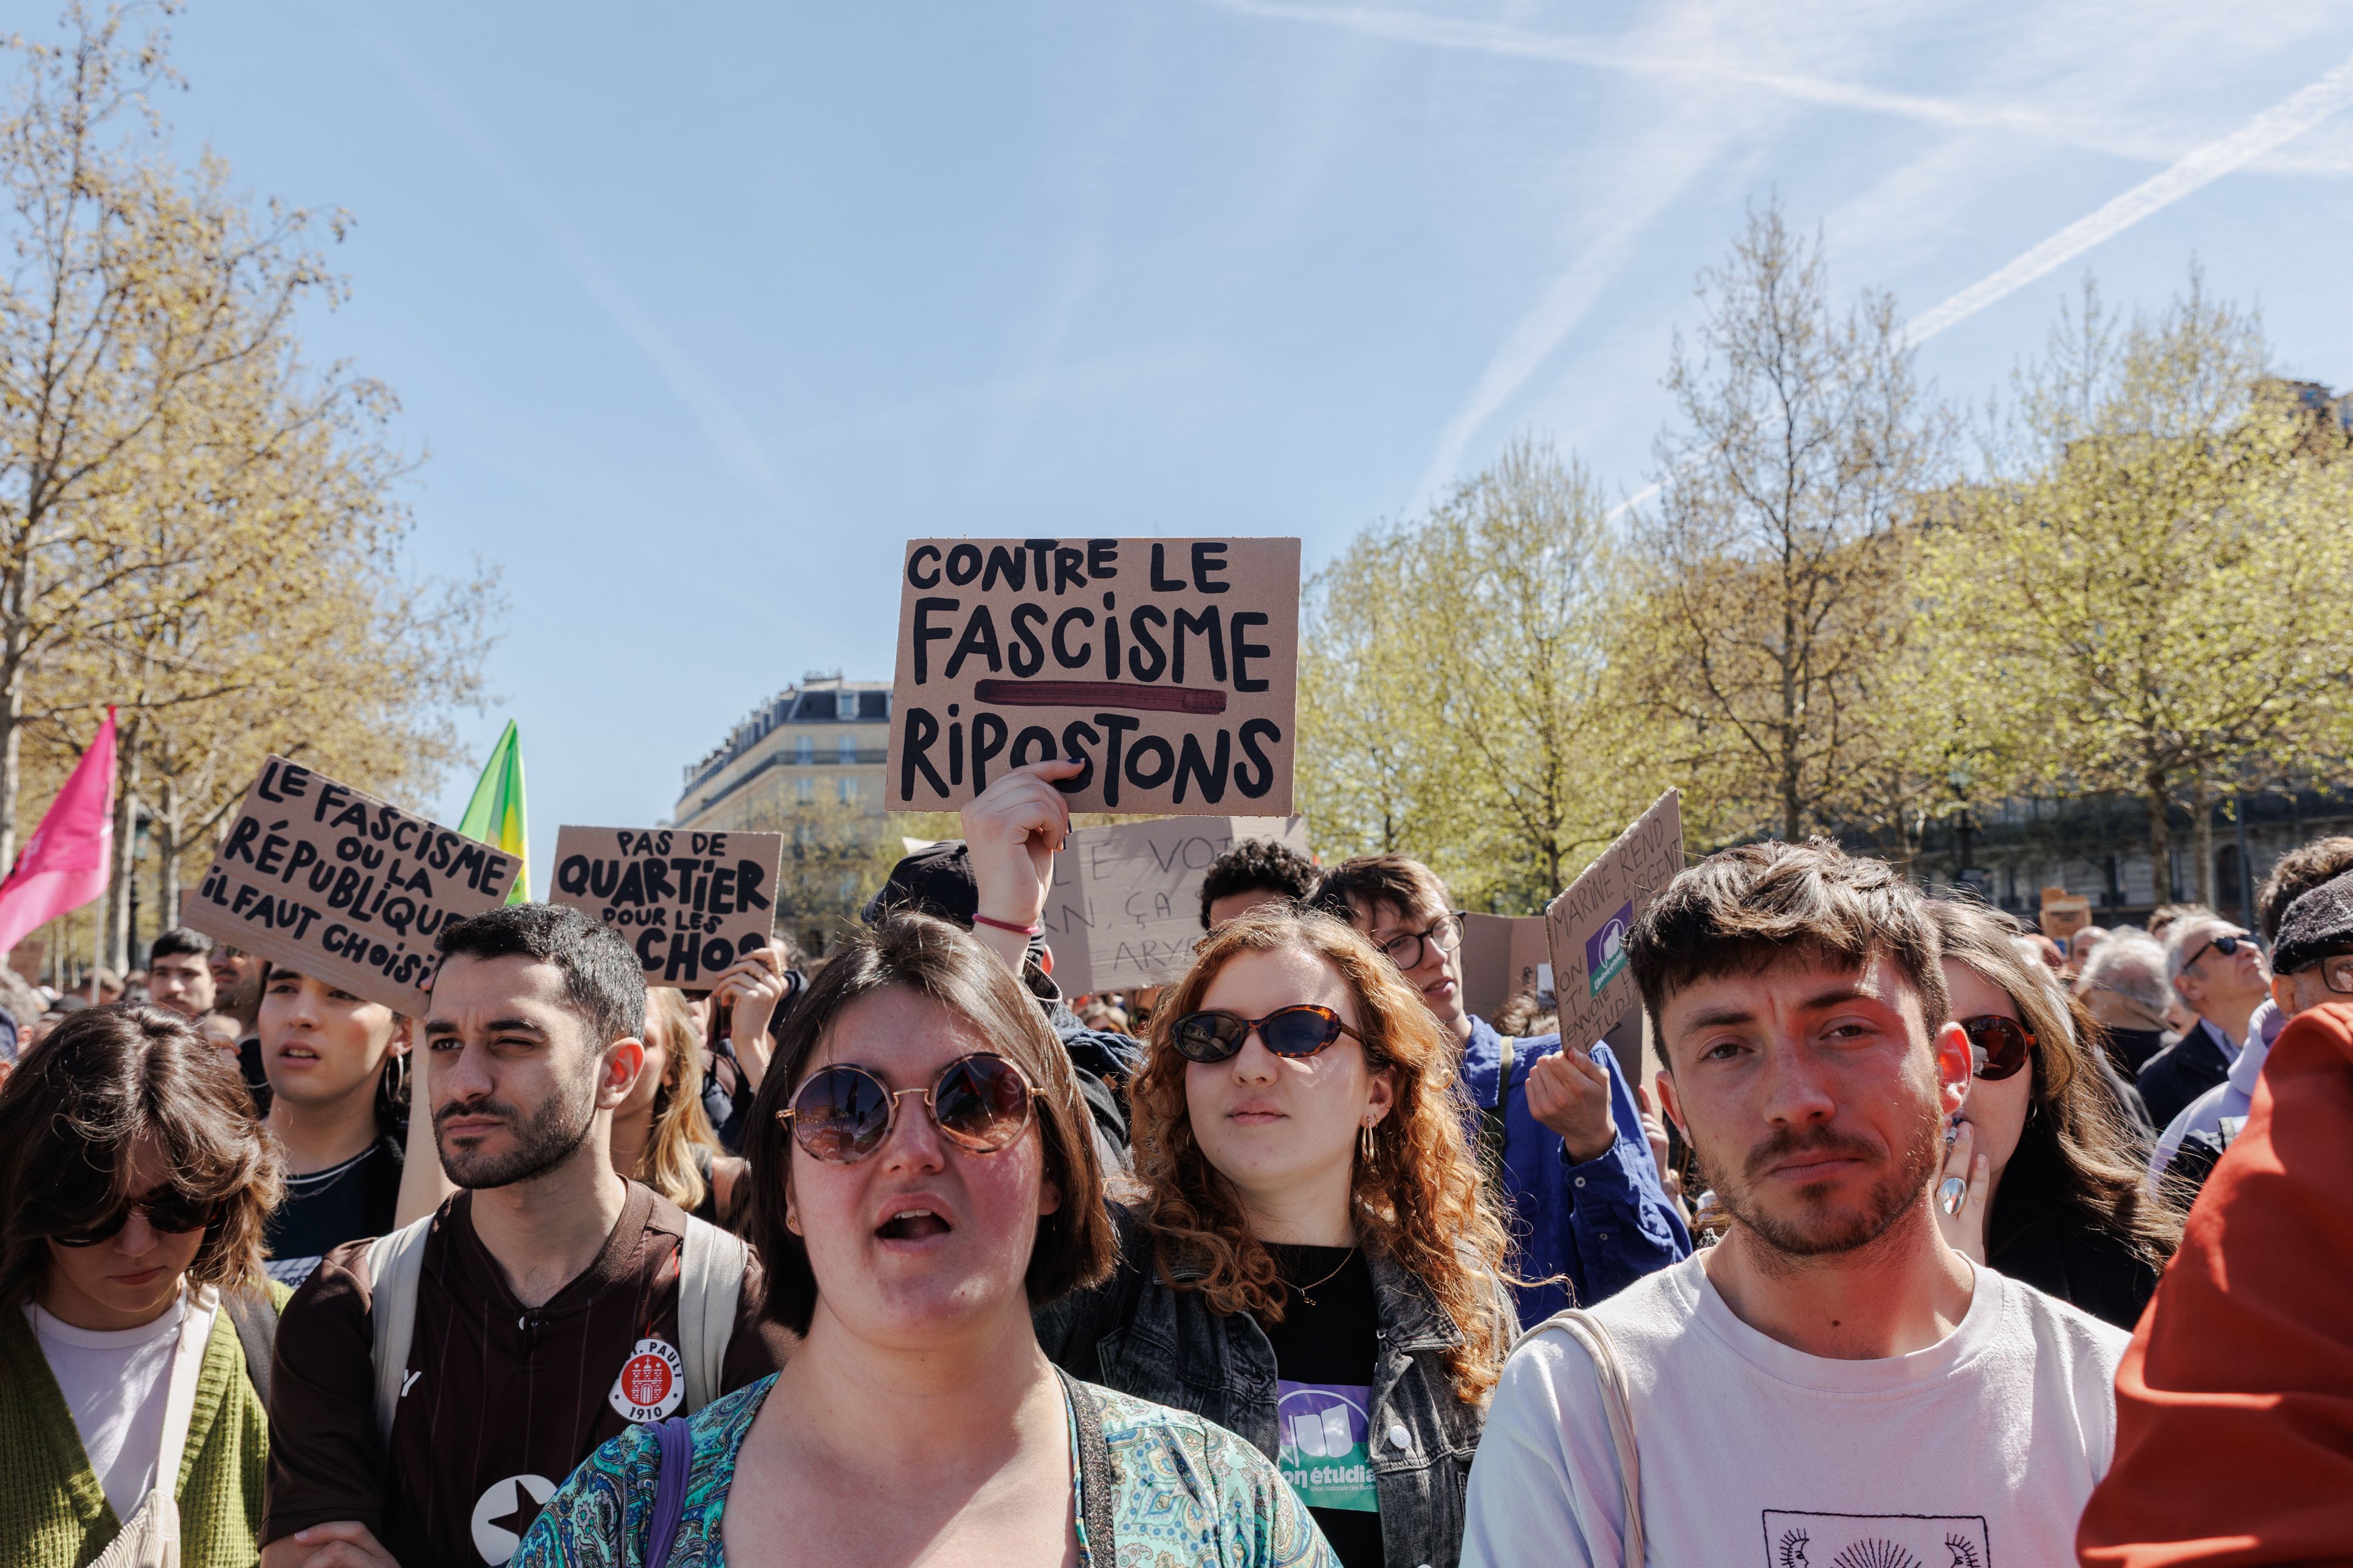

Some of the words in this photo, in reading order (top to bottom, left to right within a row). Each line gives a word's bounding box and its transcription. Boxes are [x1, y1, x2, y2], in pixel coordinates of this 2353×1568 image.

[907, 538, 1118, 595] CONTRE
[1150, 542, 1231, 594] LE
[258, 761, 311, 803] LE
[617, 830, 674, 857] PAS
[692, 832, 727, 857] DE
[1618, 818, 1664, 882] REND
[336, 837, 384, 869] OU
[388, 858, 433, 899] LA
[232, 884, 321, 940] FAUT
[602, 907, 667, 926] POUR
[675, 910, 723, 934] LES
[1125, 891, 1171, 930] ÇA
[1560, 956, 1582, 992] ON
[649, 1341, 682, 1378] PAULI
[629, 1406, 662, 1420] 1910
[1310, 1464, 1376, 1484] étudia
